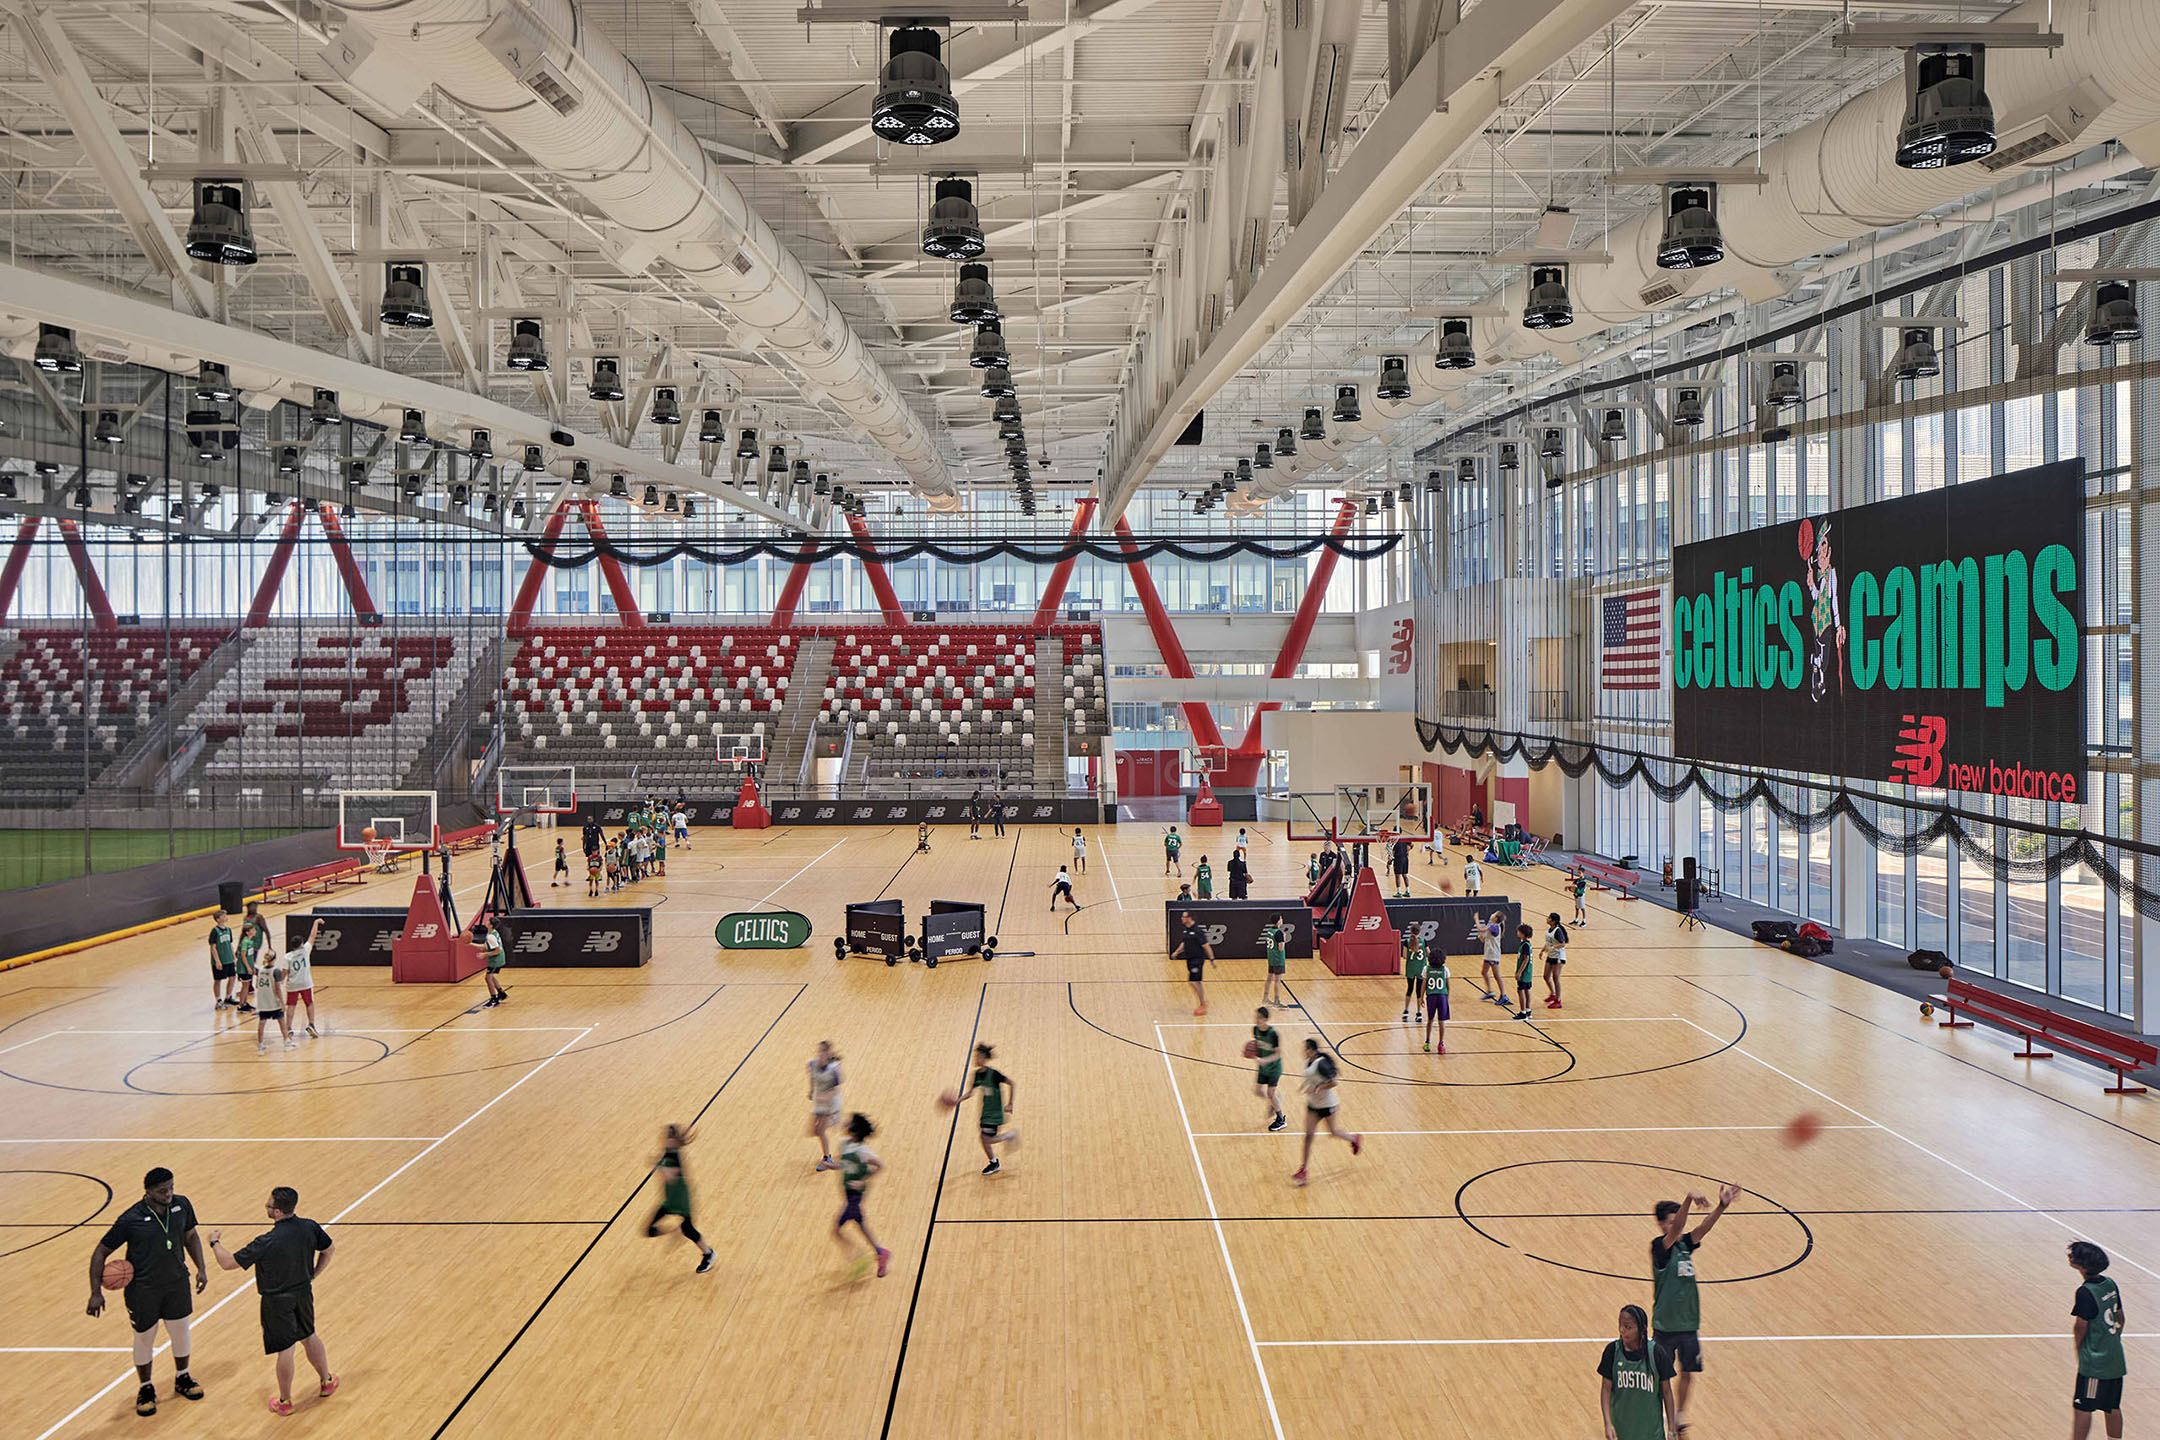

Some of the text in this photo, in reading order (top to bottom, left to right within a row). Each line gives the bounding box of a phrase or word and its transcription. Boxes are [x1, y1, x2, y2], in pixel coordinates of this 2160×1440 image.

[1674, 544, 2079, 707] celtics camps
[1888, 714, 1947, 786] NB
[1949, 759, 2077, 803] new balance
[711, 808, 732, 819] NB
[780, 807, 801, 819] NB
[814, 807, 836, 819] NB
[852, 807, 874, 819] NB
[887, 807, 908, 819] NB
[925, 806, 947, 818] NB
[1032, 806, 1054, 818] NB
[1355, 916, 1383, 931] NB
[411, 923, 438, 938] NB
[734, 918, 789, 943] CELTICS
[851, 930, 898, 942] HOME GUEST
[927, 930, 980, 943] HOME GUEST
[512, 931, 553, 953] NB
[581, 930, 622, 952] NB
[866, 946, 882, 954] PERIOD
[945, 947, 963, 955] PERIOD
[1427, 977, 1444, 990] 90
[1617, 1370, 1654, 1392] BOSTON
